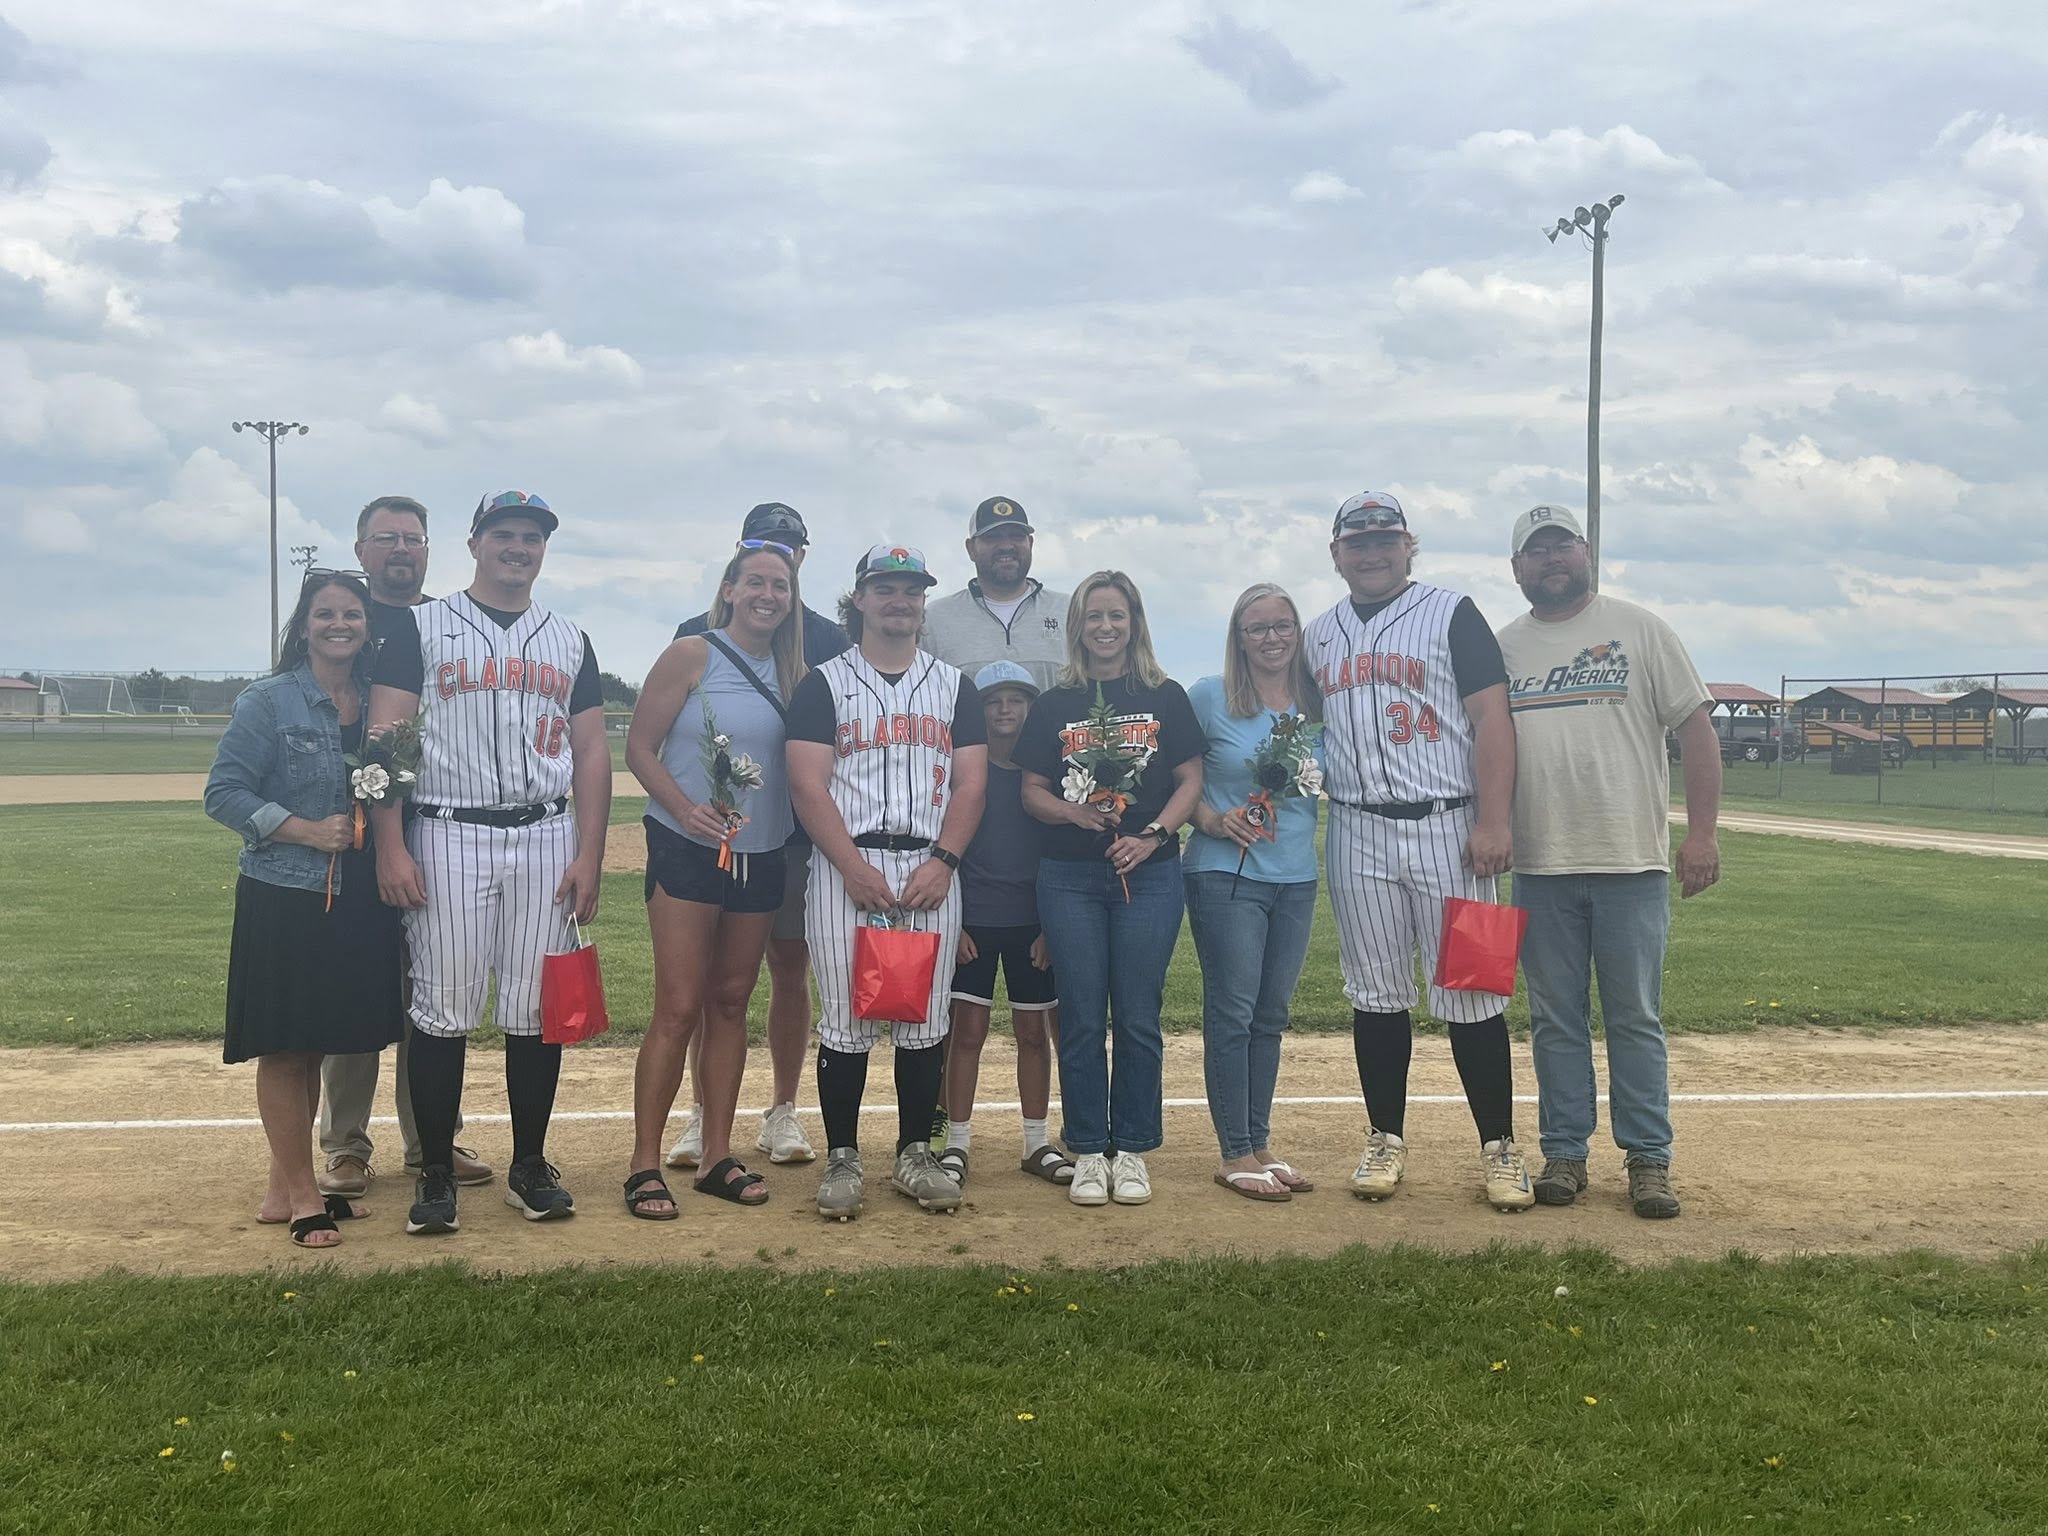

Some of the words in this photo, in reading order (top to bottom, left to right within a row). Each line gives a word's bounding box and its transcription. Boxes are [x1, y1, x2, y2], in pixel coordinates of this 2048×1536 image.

[437, 656, 572, 706] CLARION
[1506, 676, 1536, 694] ULF
[1541, 665, 1629, 693] AMERICA
[534, 714, 566, 759] 18
[835, 713, 953, 759] CLARION
[1386, 701, 1441, 745] 34
[931, 764, 947, 809] 2
